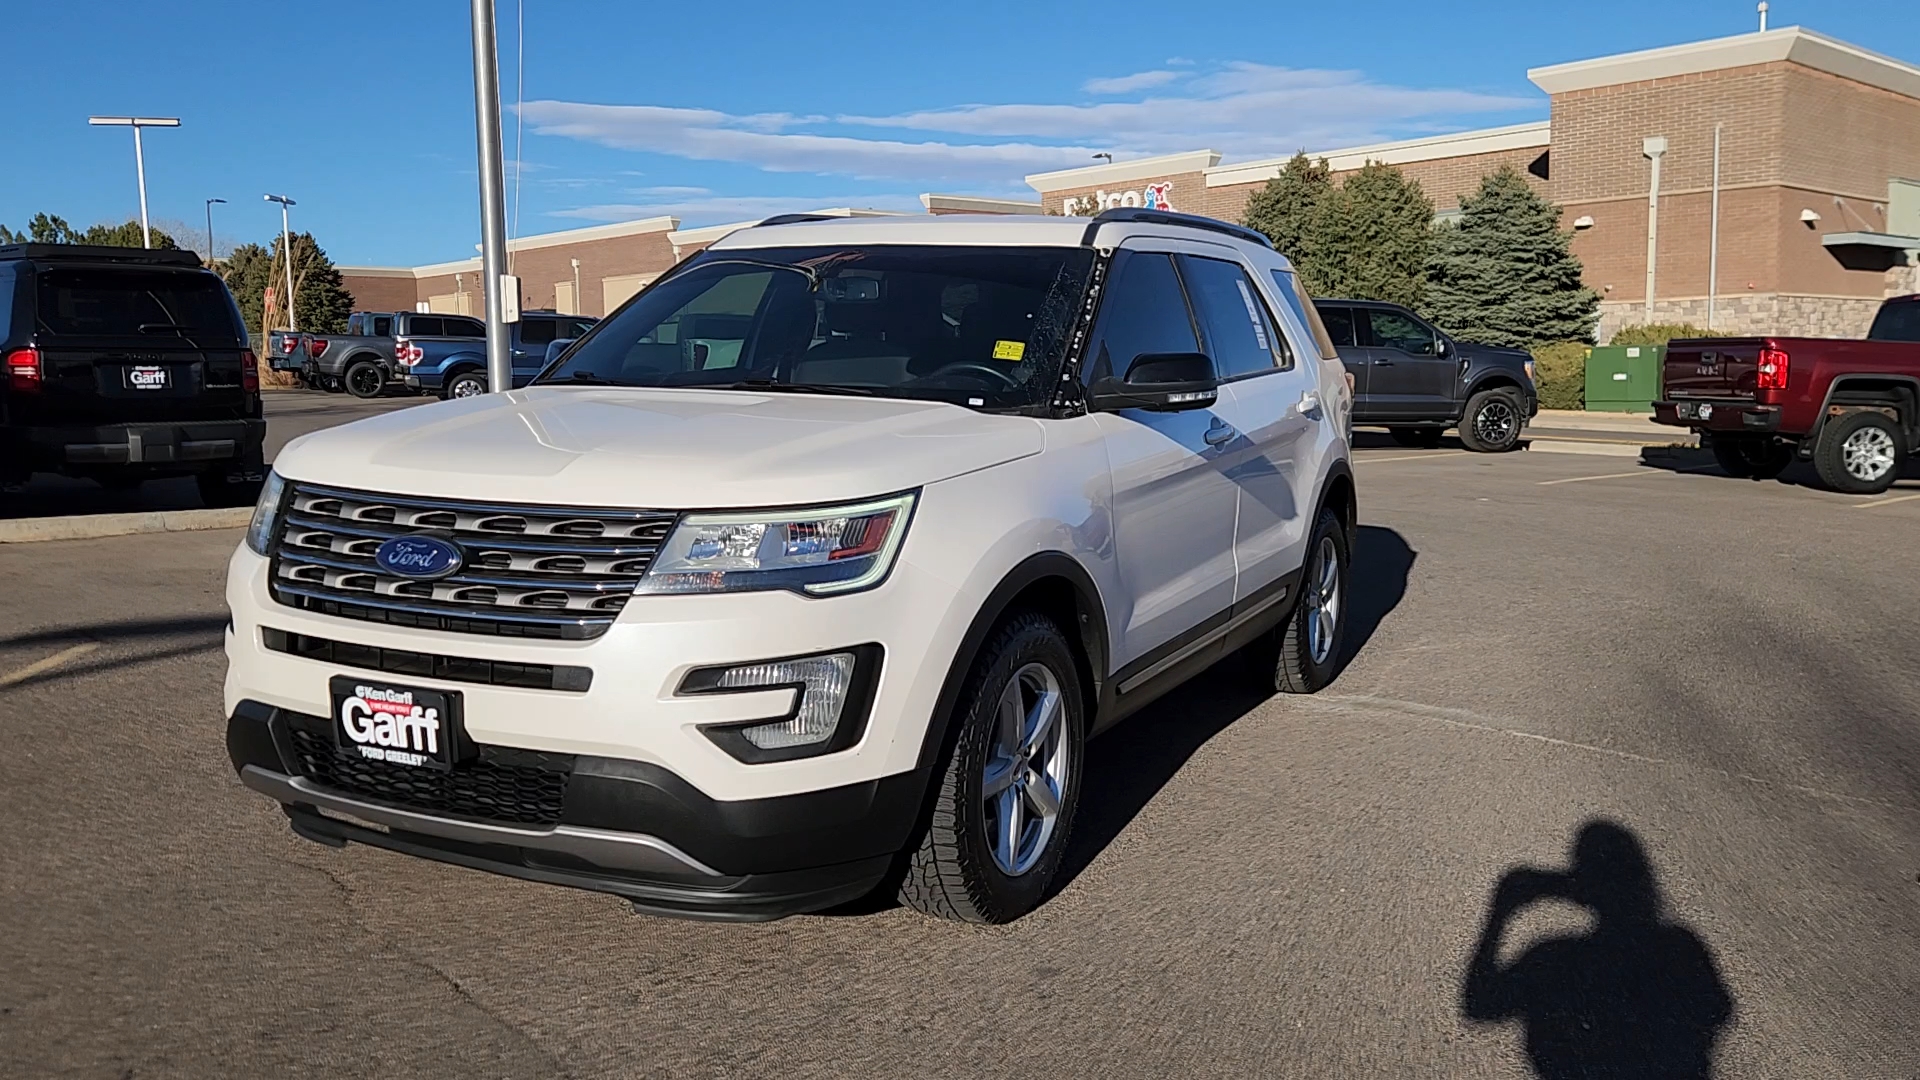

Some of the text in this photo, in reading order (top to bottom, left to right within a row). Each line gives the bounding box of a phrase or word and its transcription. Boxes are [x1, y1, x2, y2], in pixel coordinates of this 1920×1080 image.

[130, 371, 166, 384] Garff
[388, 541, 438, 567] Ford
[342, 696, 439, 753] Garff
